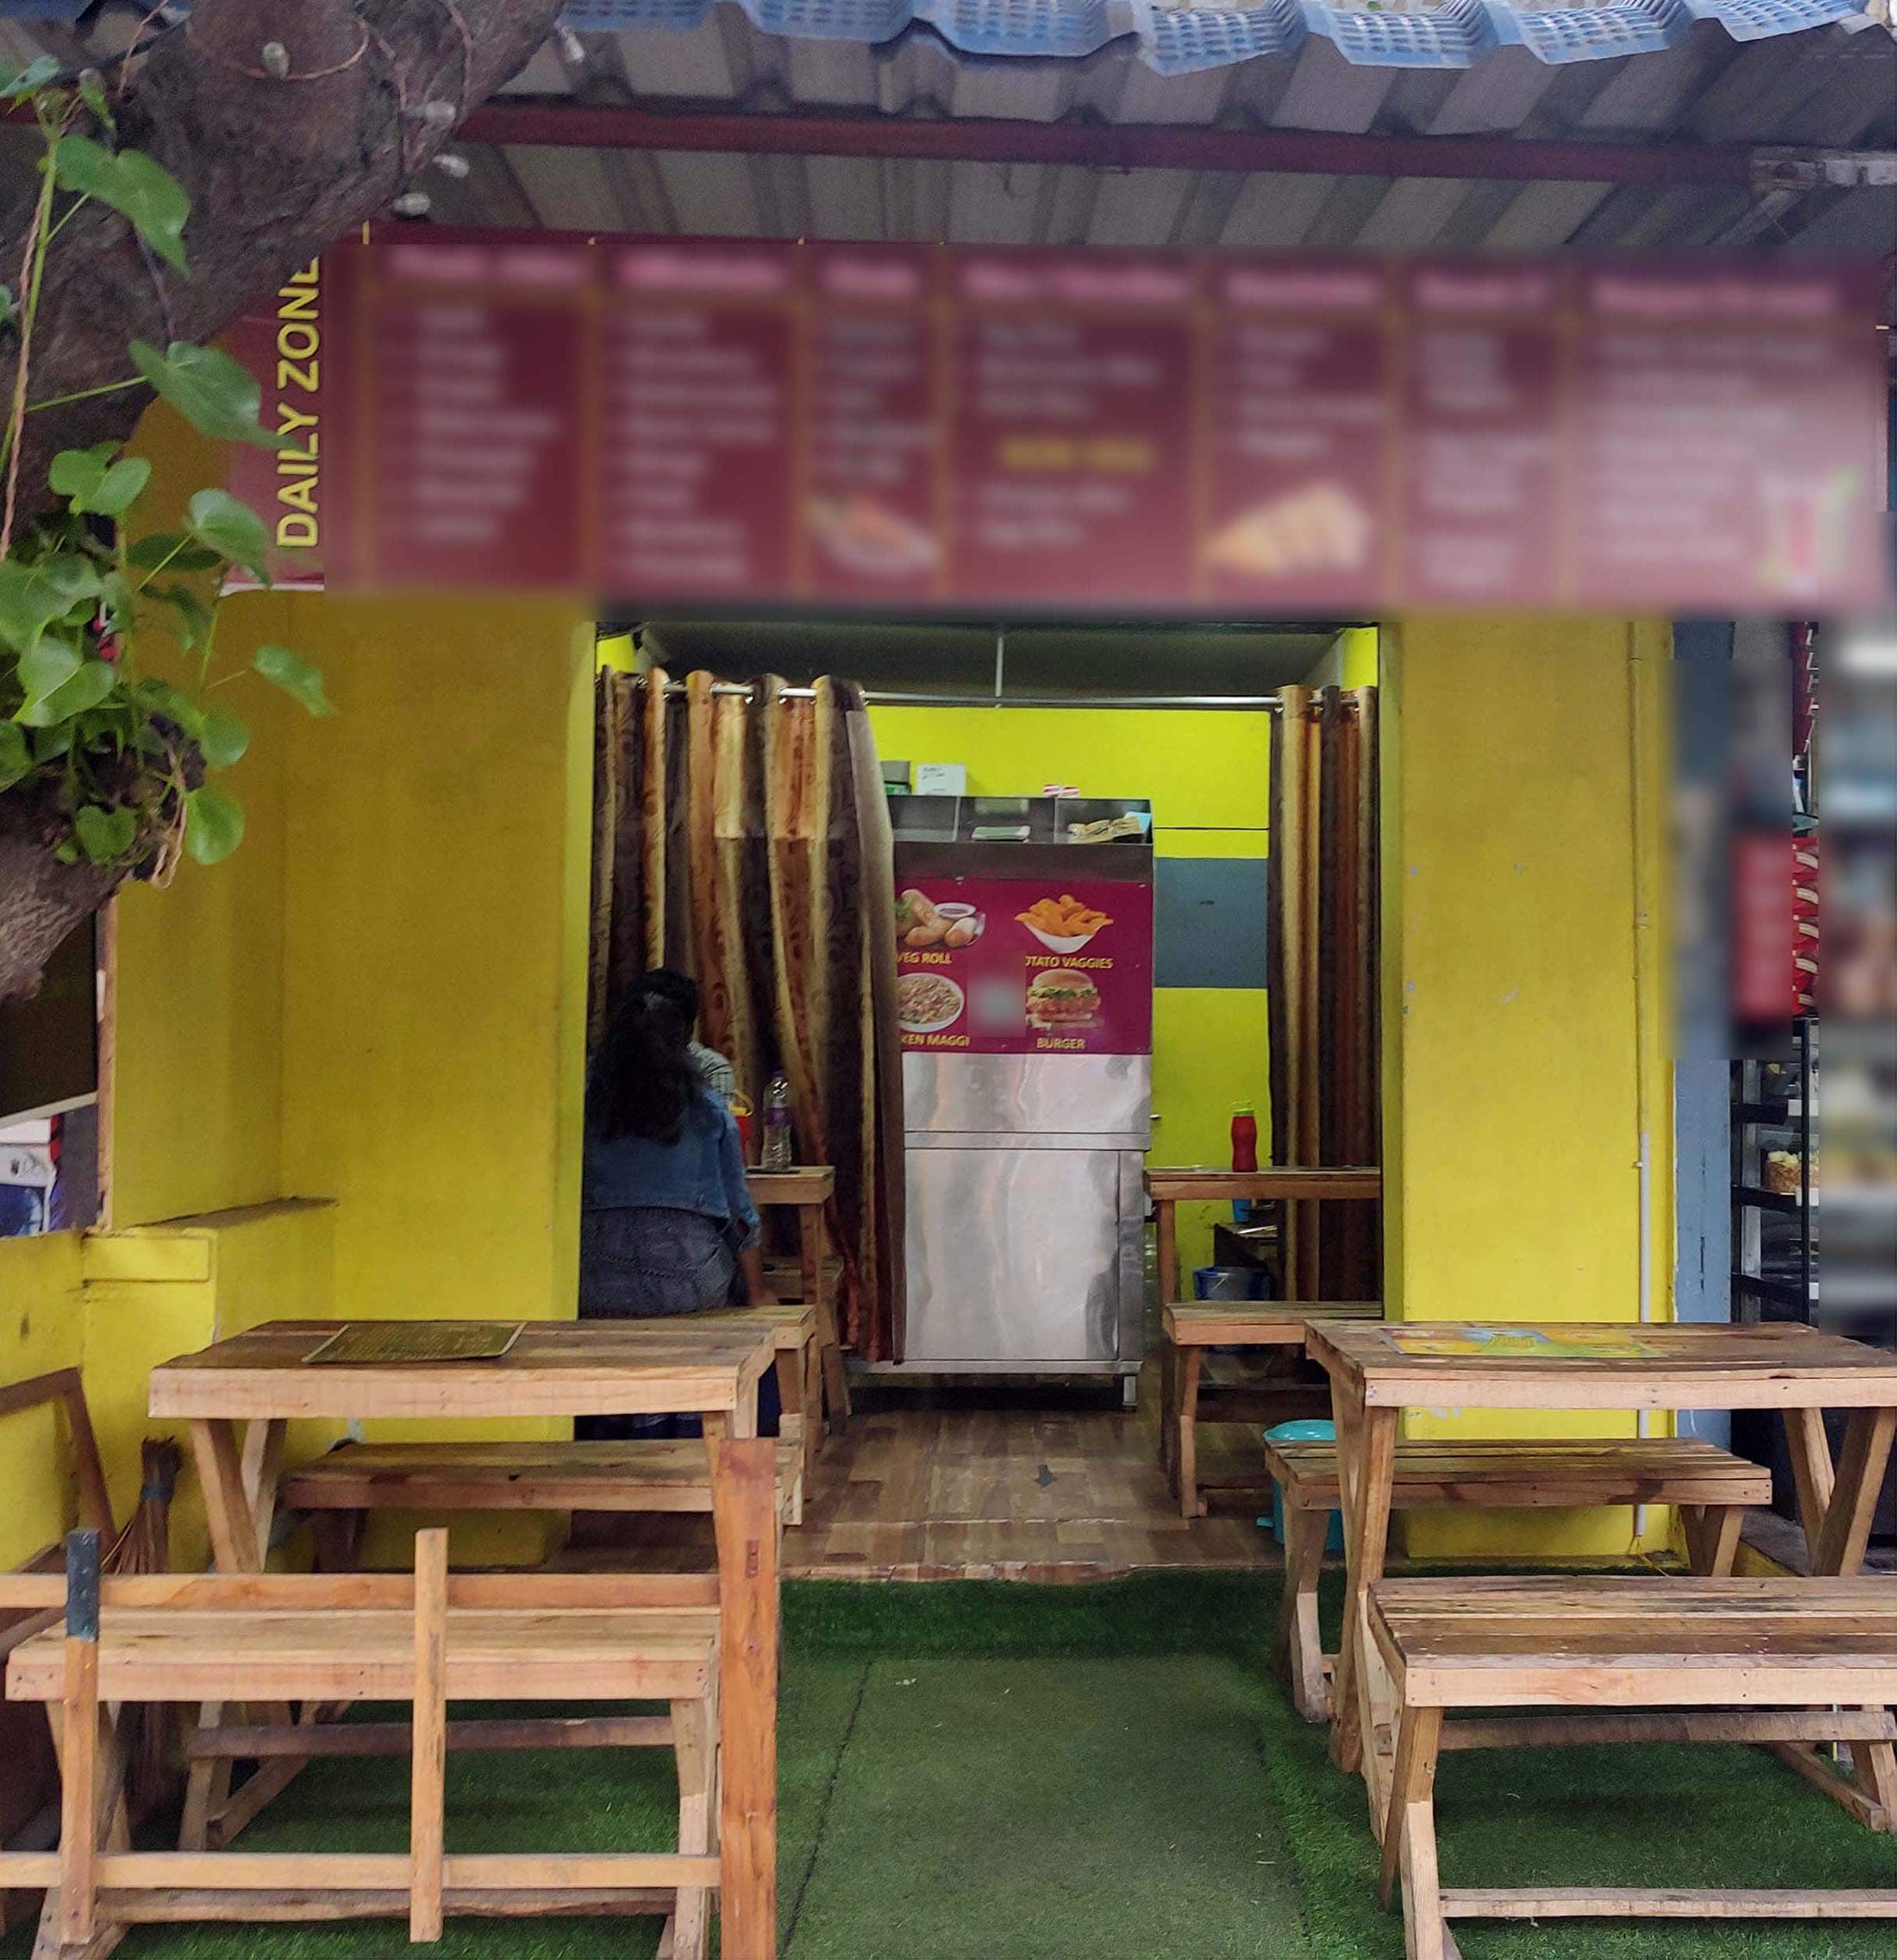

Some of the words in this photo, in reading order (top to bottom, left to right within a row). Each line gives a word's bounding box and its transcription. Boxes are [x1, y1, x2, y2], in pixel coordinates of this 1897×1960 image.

[276, 401, 319, 547] DAILY
[922, 952, 952, 964] ROLL
[1061, 956, 1114, 969] VAGGIES
[926, 1034, 971, 1047] MAGGI
[1036, 1037, 1086, 1050] BURGER
